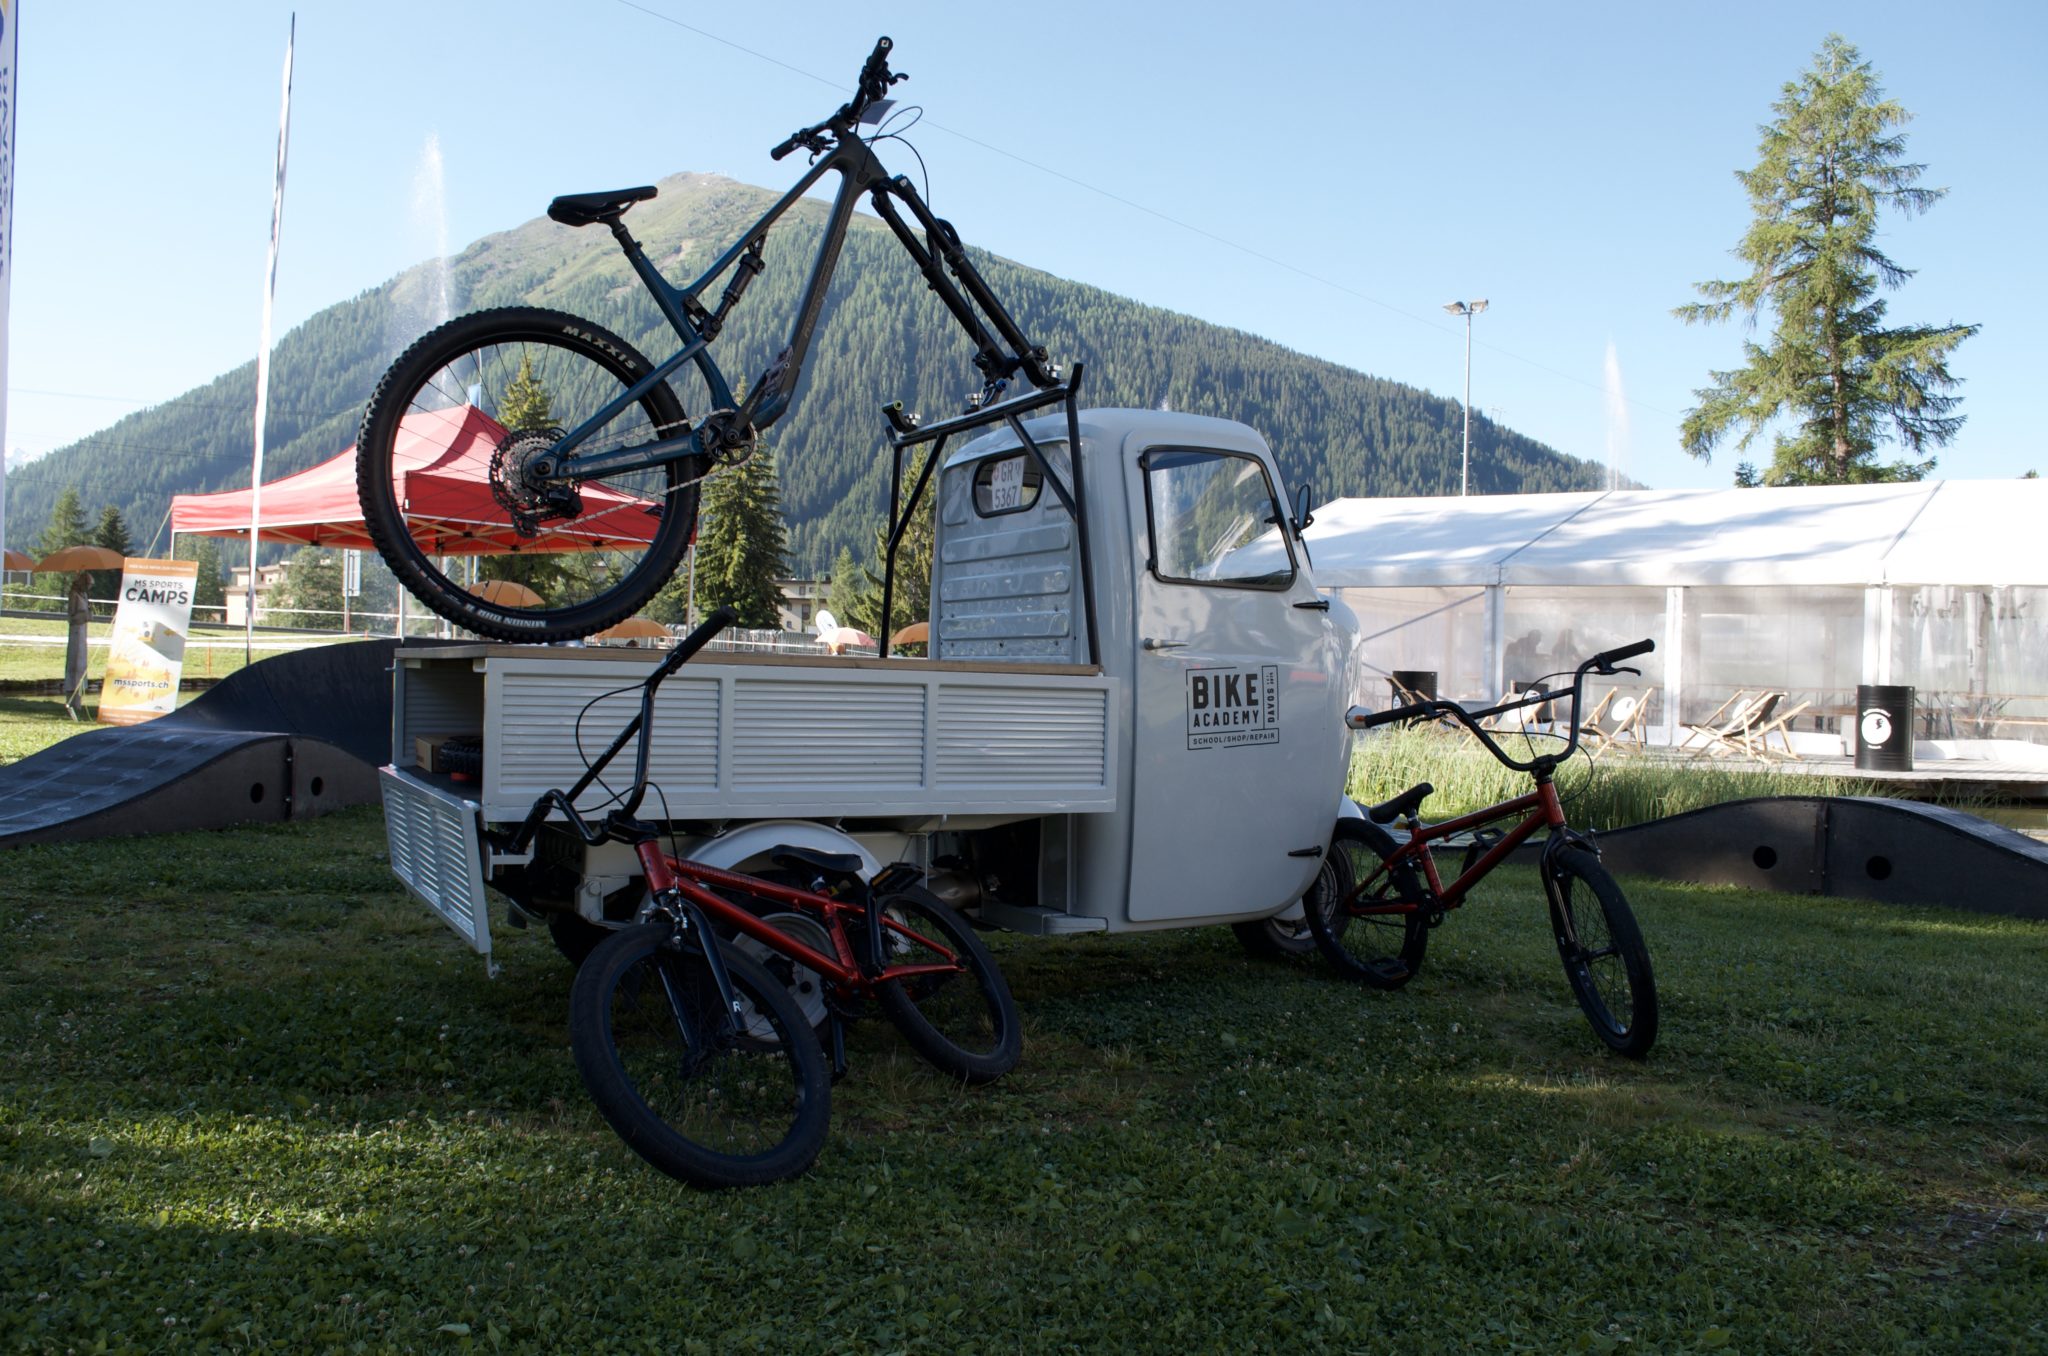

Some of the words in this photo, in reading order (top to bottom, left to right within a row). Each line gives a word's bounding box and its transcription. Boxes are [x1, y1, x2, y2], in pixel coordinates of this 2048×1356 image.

[562, 325, 637, 369] MAXXIS
[1001, 462, 1014, 482] GR
[995, 486, 1018, 508] 5367
[149, 580, 184, 589] SPORTS
[125, 588, 189, 604] CAMPS
[113, 679, 169, 689] mssports.ch
[1192, 673, 1259, 710] BIKE
[1266, 687, 1275, 724] DAVOS
[1193, 710, 1259, 728] ACADEMY
